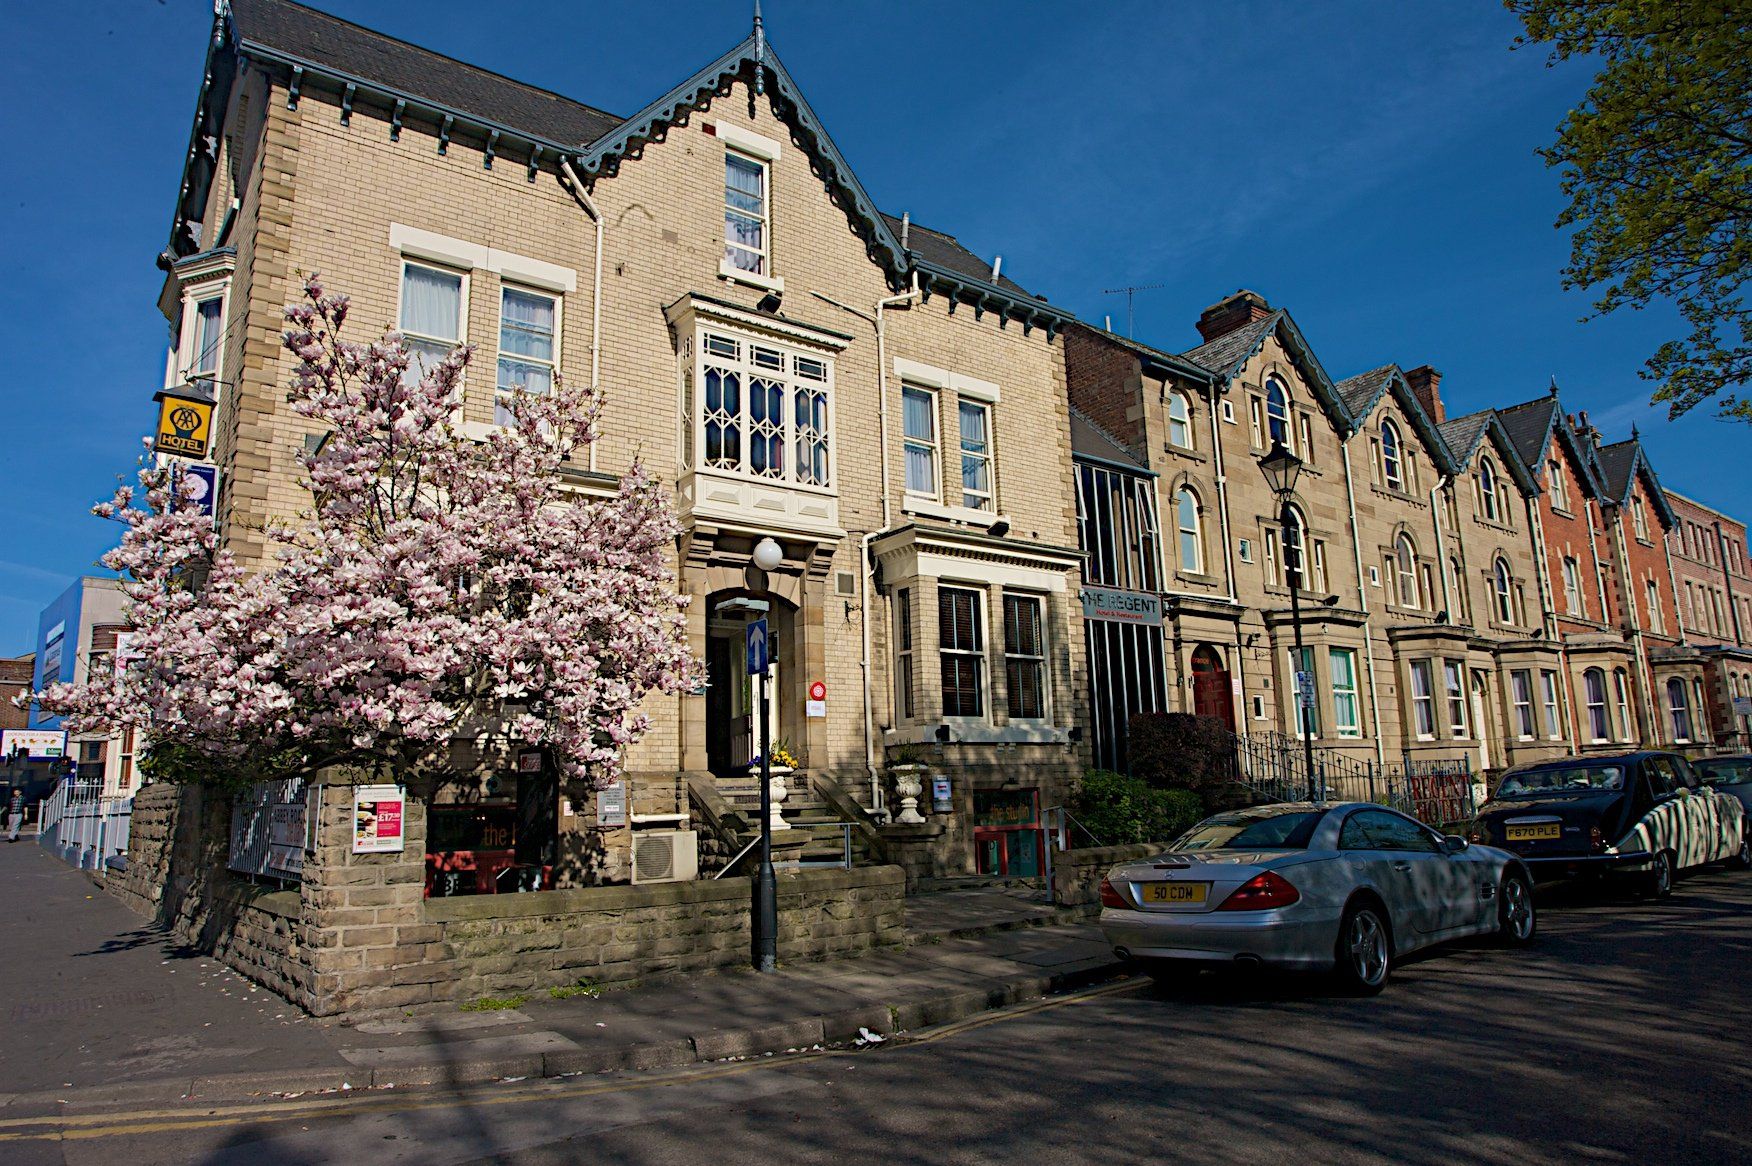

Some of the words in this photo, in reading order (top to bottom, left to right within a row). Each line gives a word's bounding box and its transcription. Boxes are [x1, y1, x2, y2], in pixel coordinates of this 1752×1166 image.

[162, 434, 202, 450] HOTEL
[1108, 594, 1157, 613] REGENT
[1117, 611, 1143, 619] Restaurant
[1410, 773, 1469, 800] REGENT
[1415, 797, 1469, 823] HOTEL
[483, 822, 507, 846] the
[1508, 827, 1535, 838] F670
[1537, 826, 1558, 836] PLE
[1153, 887, 1167, 899] 50
[1170, 886, 1193, 899] CDM
